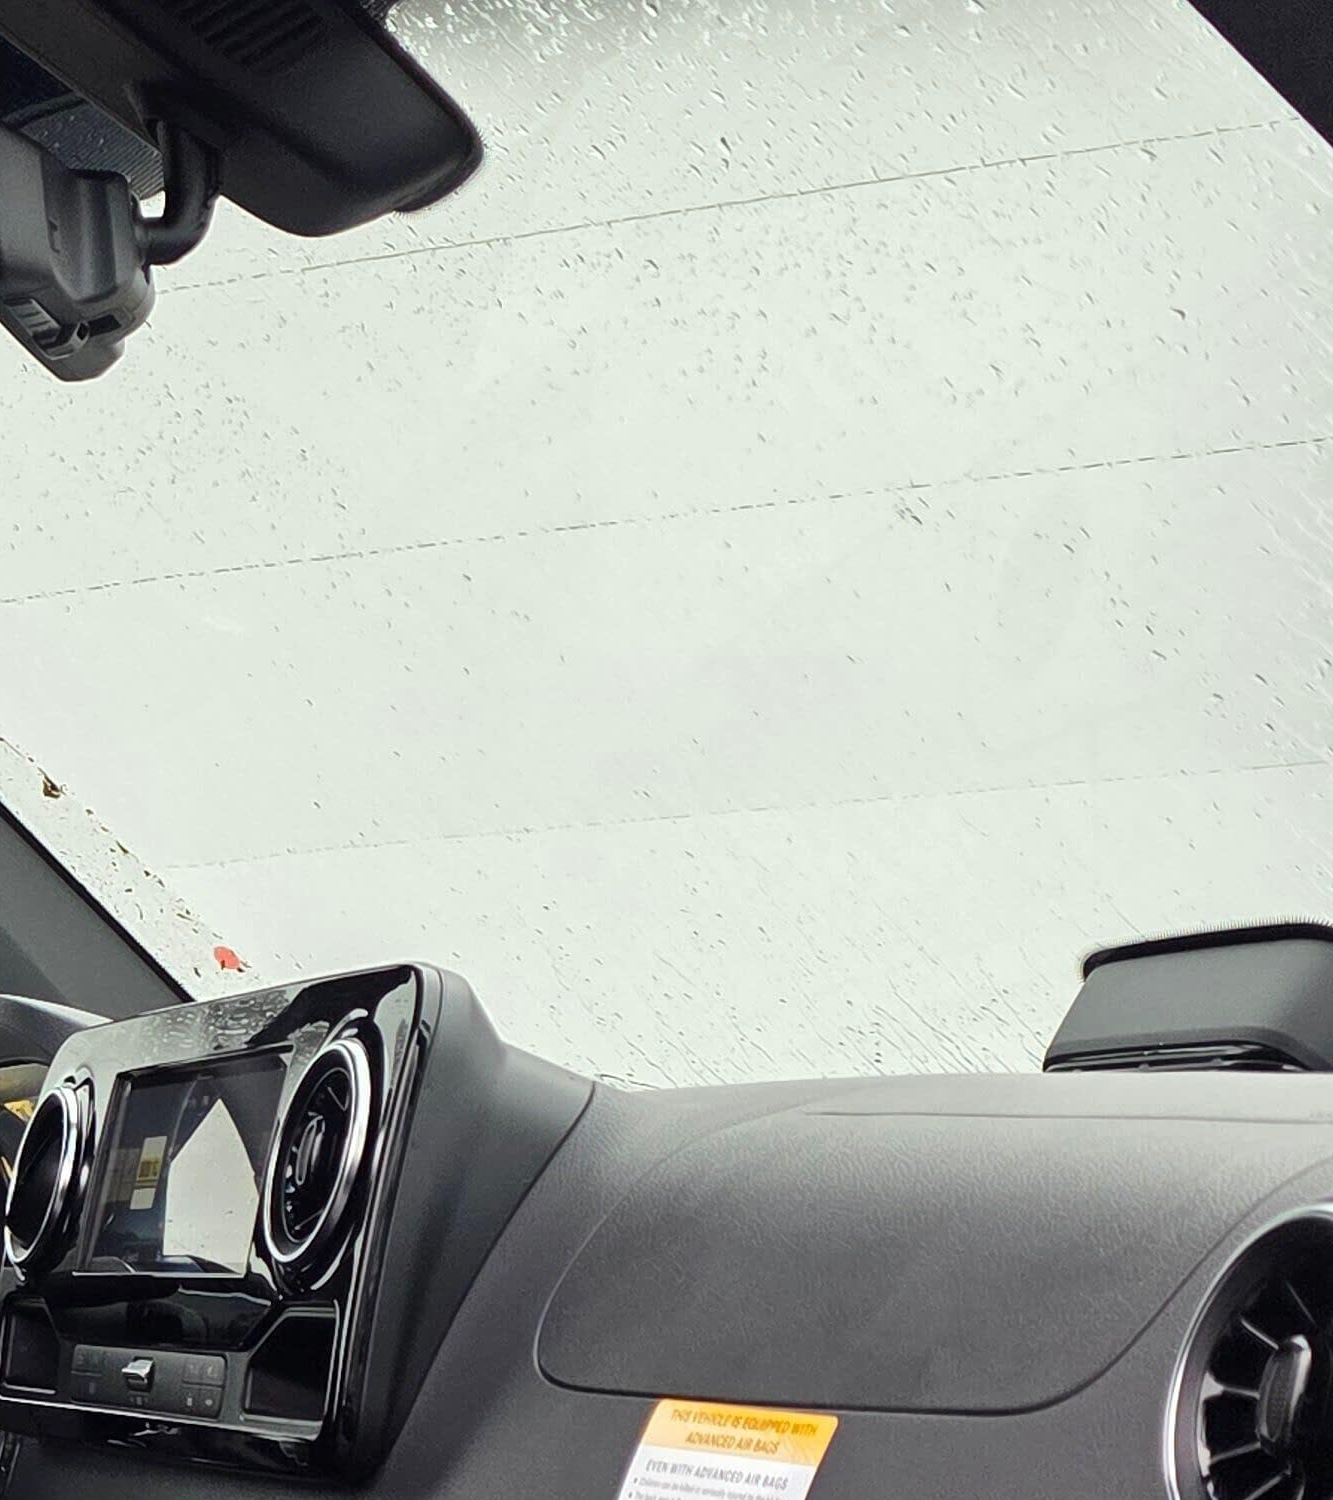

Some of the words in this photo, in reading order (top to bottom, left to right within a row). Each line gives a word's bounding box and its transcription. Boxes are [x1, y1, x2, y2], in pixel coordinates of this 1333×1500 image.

[670, 1408, 691, 1423] THIS
[693, 1411, 731, 1428] VEHICLE
[742, 1416, 790, 1434] EQUIPPED
[791, 1423, 819, 1436] WITH
[685, 1432, 735, 1449] ADVANCED
[736, 1437, 753, 1451] AIR
[753, 1439, 780, 1455] BAGS
[645, 1459, 668, 1473] EVEN
[670, 1461, 693, 1475] WITH
[694, 1464, 744, 1483] ADVANCED
[744, 1472, 762, 1487] AIR
[762, 1475, 789, 1491] BAGS
